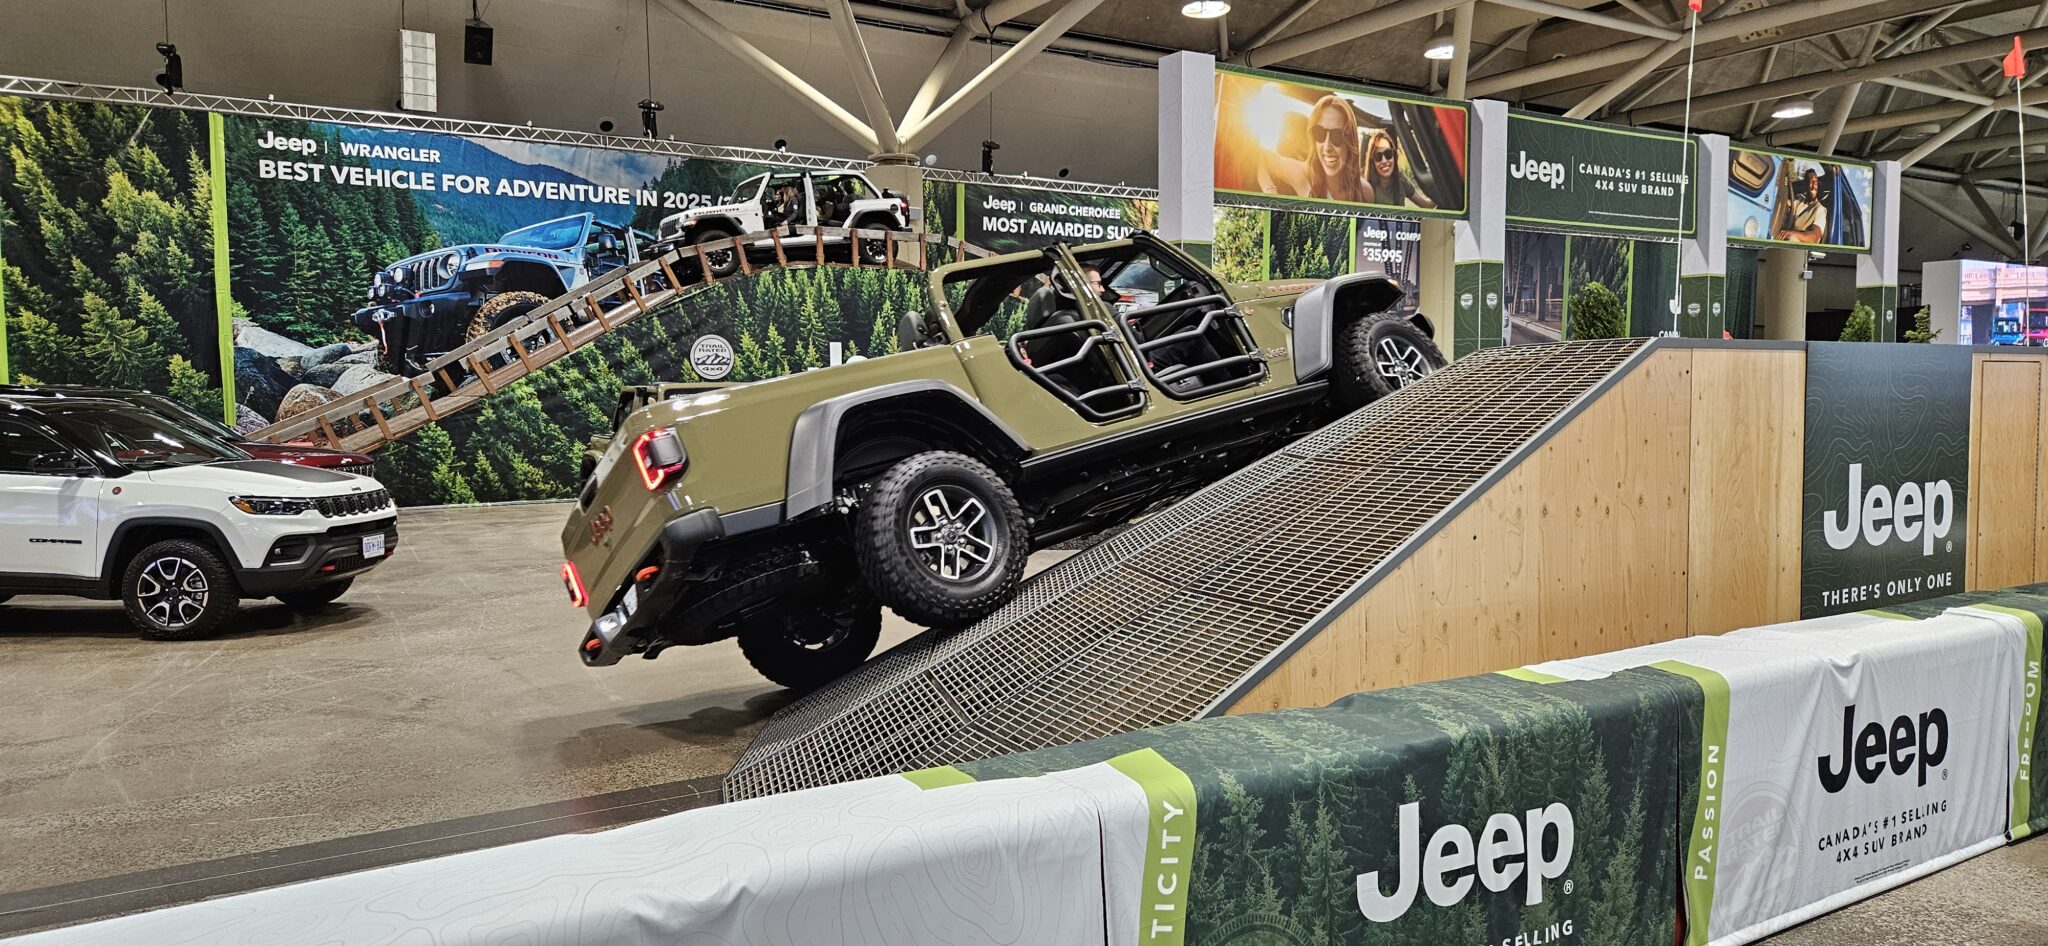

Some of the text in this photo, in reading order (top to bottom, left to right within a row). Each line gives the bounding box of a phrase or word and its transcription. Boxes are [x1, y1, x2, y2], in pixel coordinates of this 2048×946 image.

[257, 131, 441, 163] Jeep WRANGLER
[258, 159, 324, 183] BEST
[329, 164, 436, 191] VEHICLE
[442, 173, 490, 195] FOR
[495, 178, 630, 205] ADVENTURE
[636, 188, 658, 207] IN
[663, 191, 712, 209] 2025
[1510, 151, 1565, 190] Jeep
[1579, 163, 1689, 185] CANADA'S #1 SELLING
[1595, 180, 1675, 197] 4X4 SUV BRAND
[982, 195, 1121, 219] Jeep GRAND CHEROKEE
[982, 216, 1027, 234] MOST
[1030, 220, 1103, 239] AWARDED
[1363, 226, 1388, 241] Jeep
[1363, 248, 1402, 263] $35,995
[1823, 463, 1953, 556] Jeep
[1822, 571, 1953, 607] THERE'S ONLY ONE
[1817, 704, 1949, 793] Jeep
[1695, 745, 1720, 880] PASSION
[1818, 820, 1878, 851] CANADA'S
[1836, 824, 1927, 863] 4X4 SUV BRAND
[1151, 800, 1184, 939] TICITY
[1357, 802, 1575, 922] Jeep
